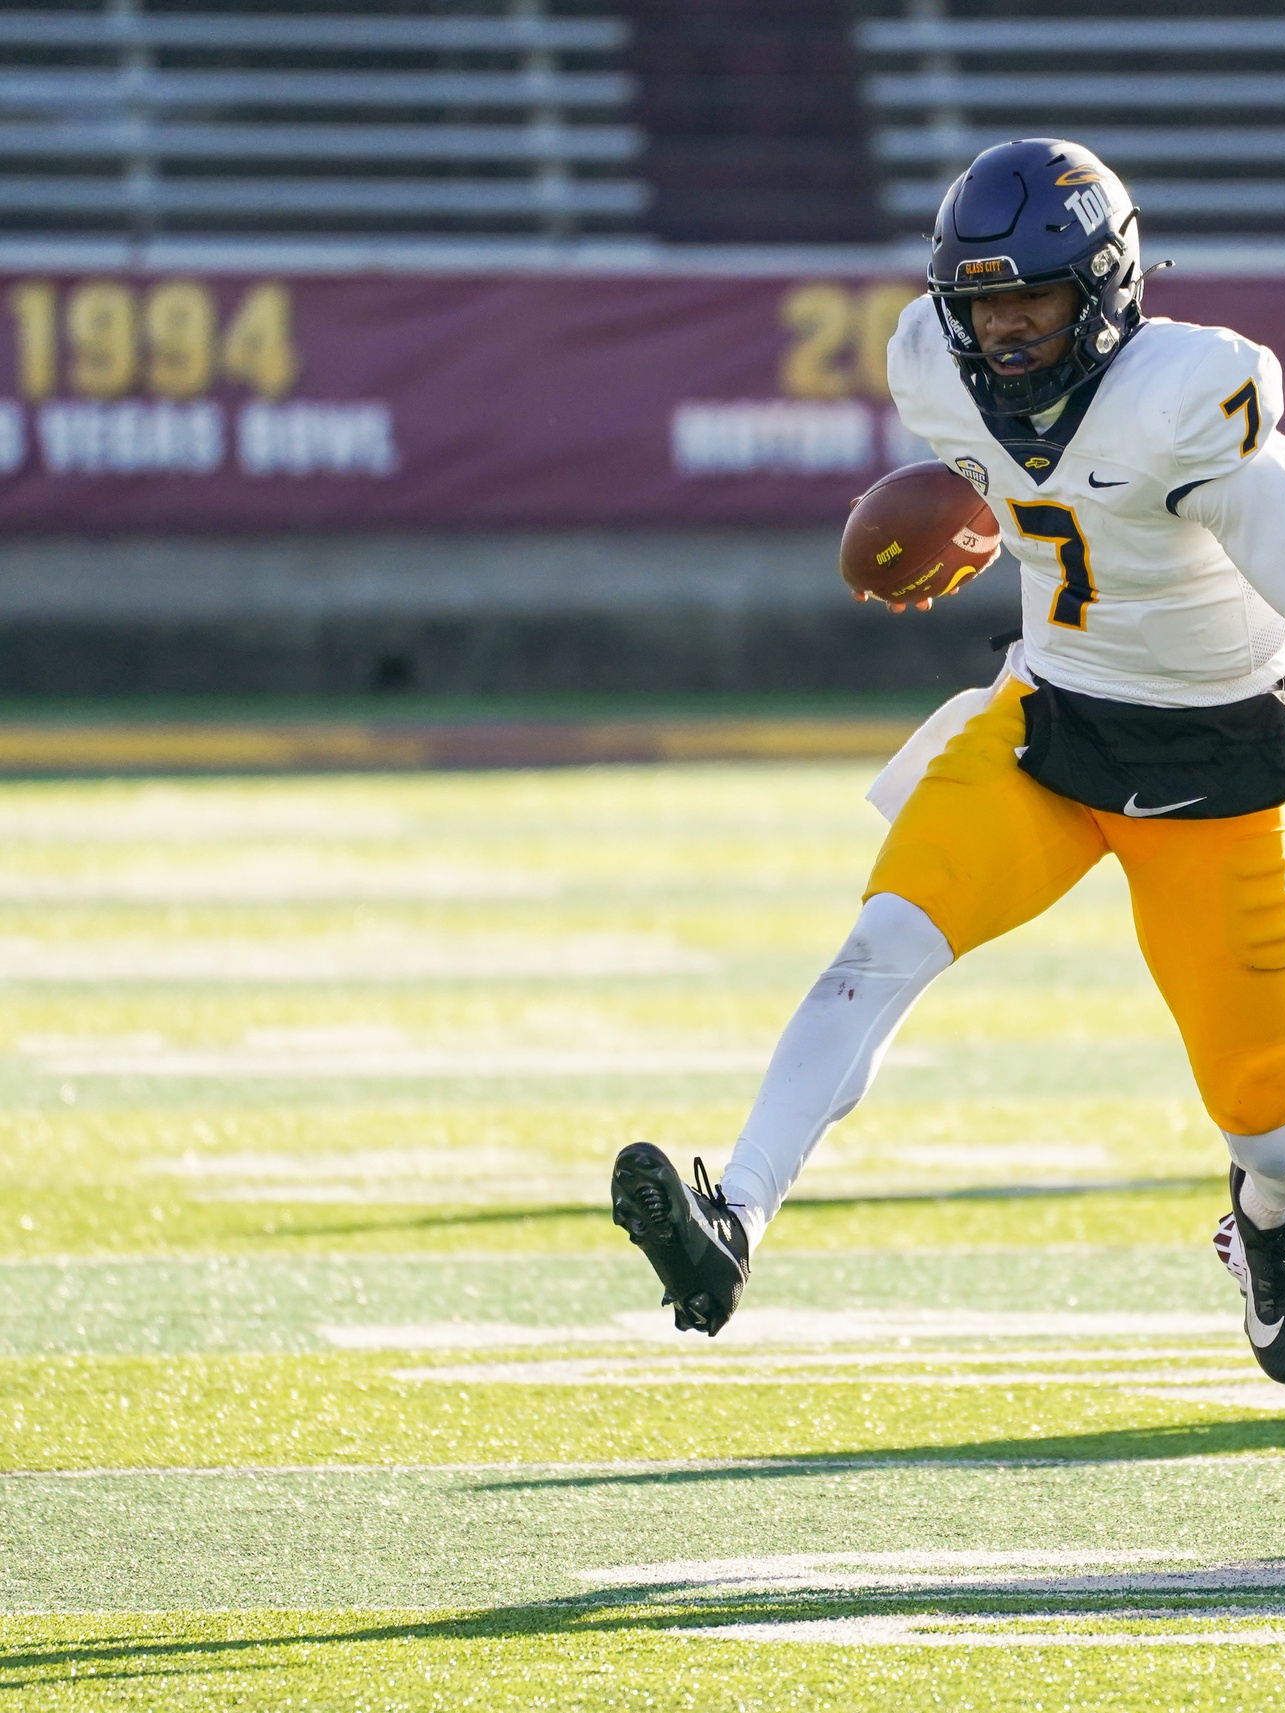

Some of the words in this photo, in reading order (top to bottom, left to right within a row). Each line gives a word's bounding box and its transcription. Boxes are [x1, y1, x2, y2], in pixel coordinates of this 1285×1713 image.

[965, 263, 984, 275] GLASS
[985, 260, 1001, 273] CITY
[12, 282, 297, 397] 1994
[1219, 377, 1262, 459] 7
[875, 541, 903, 566] TOLEDO
[1005, 498, 1099, 632] 7
[915, 562, 945, 586] VAPOR
[891, 583, 917, 597] ELITE
